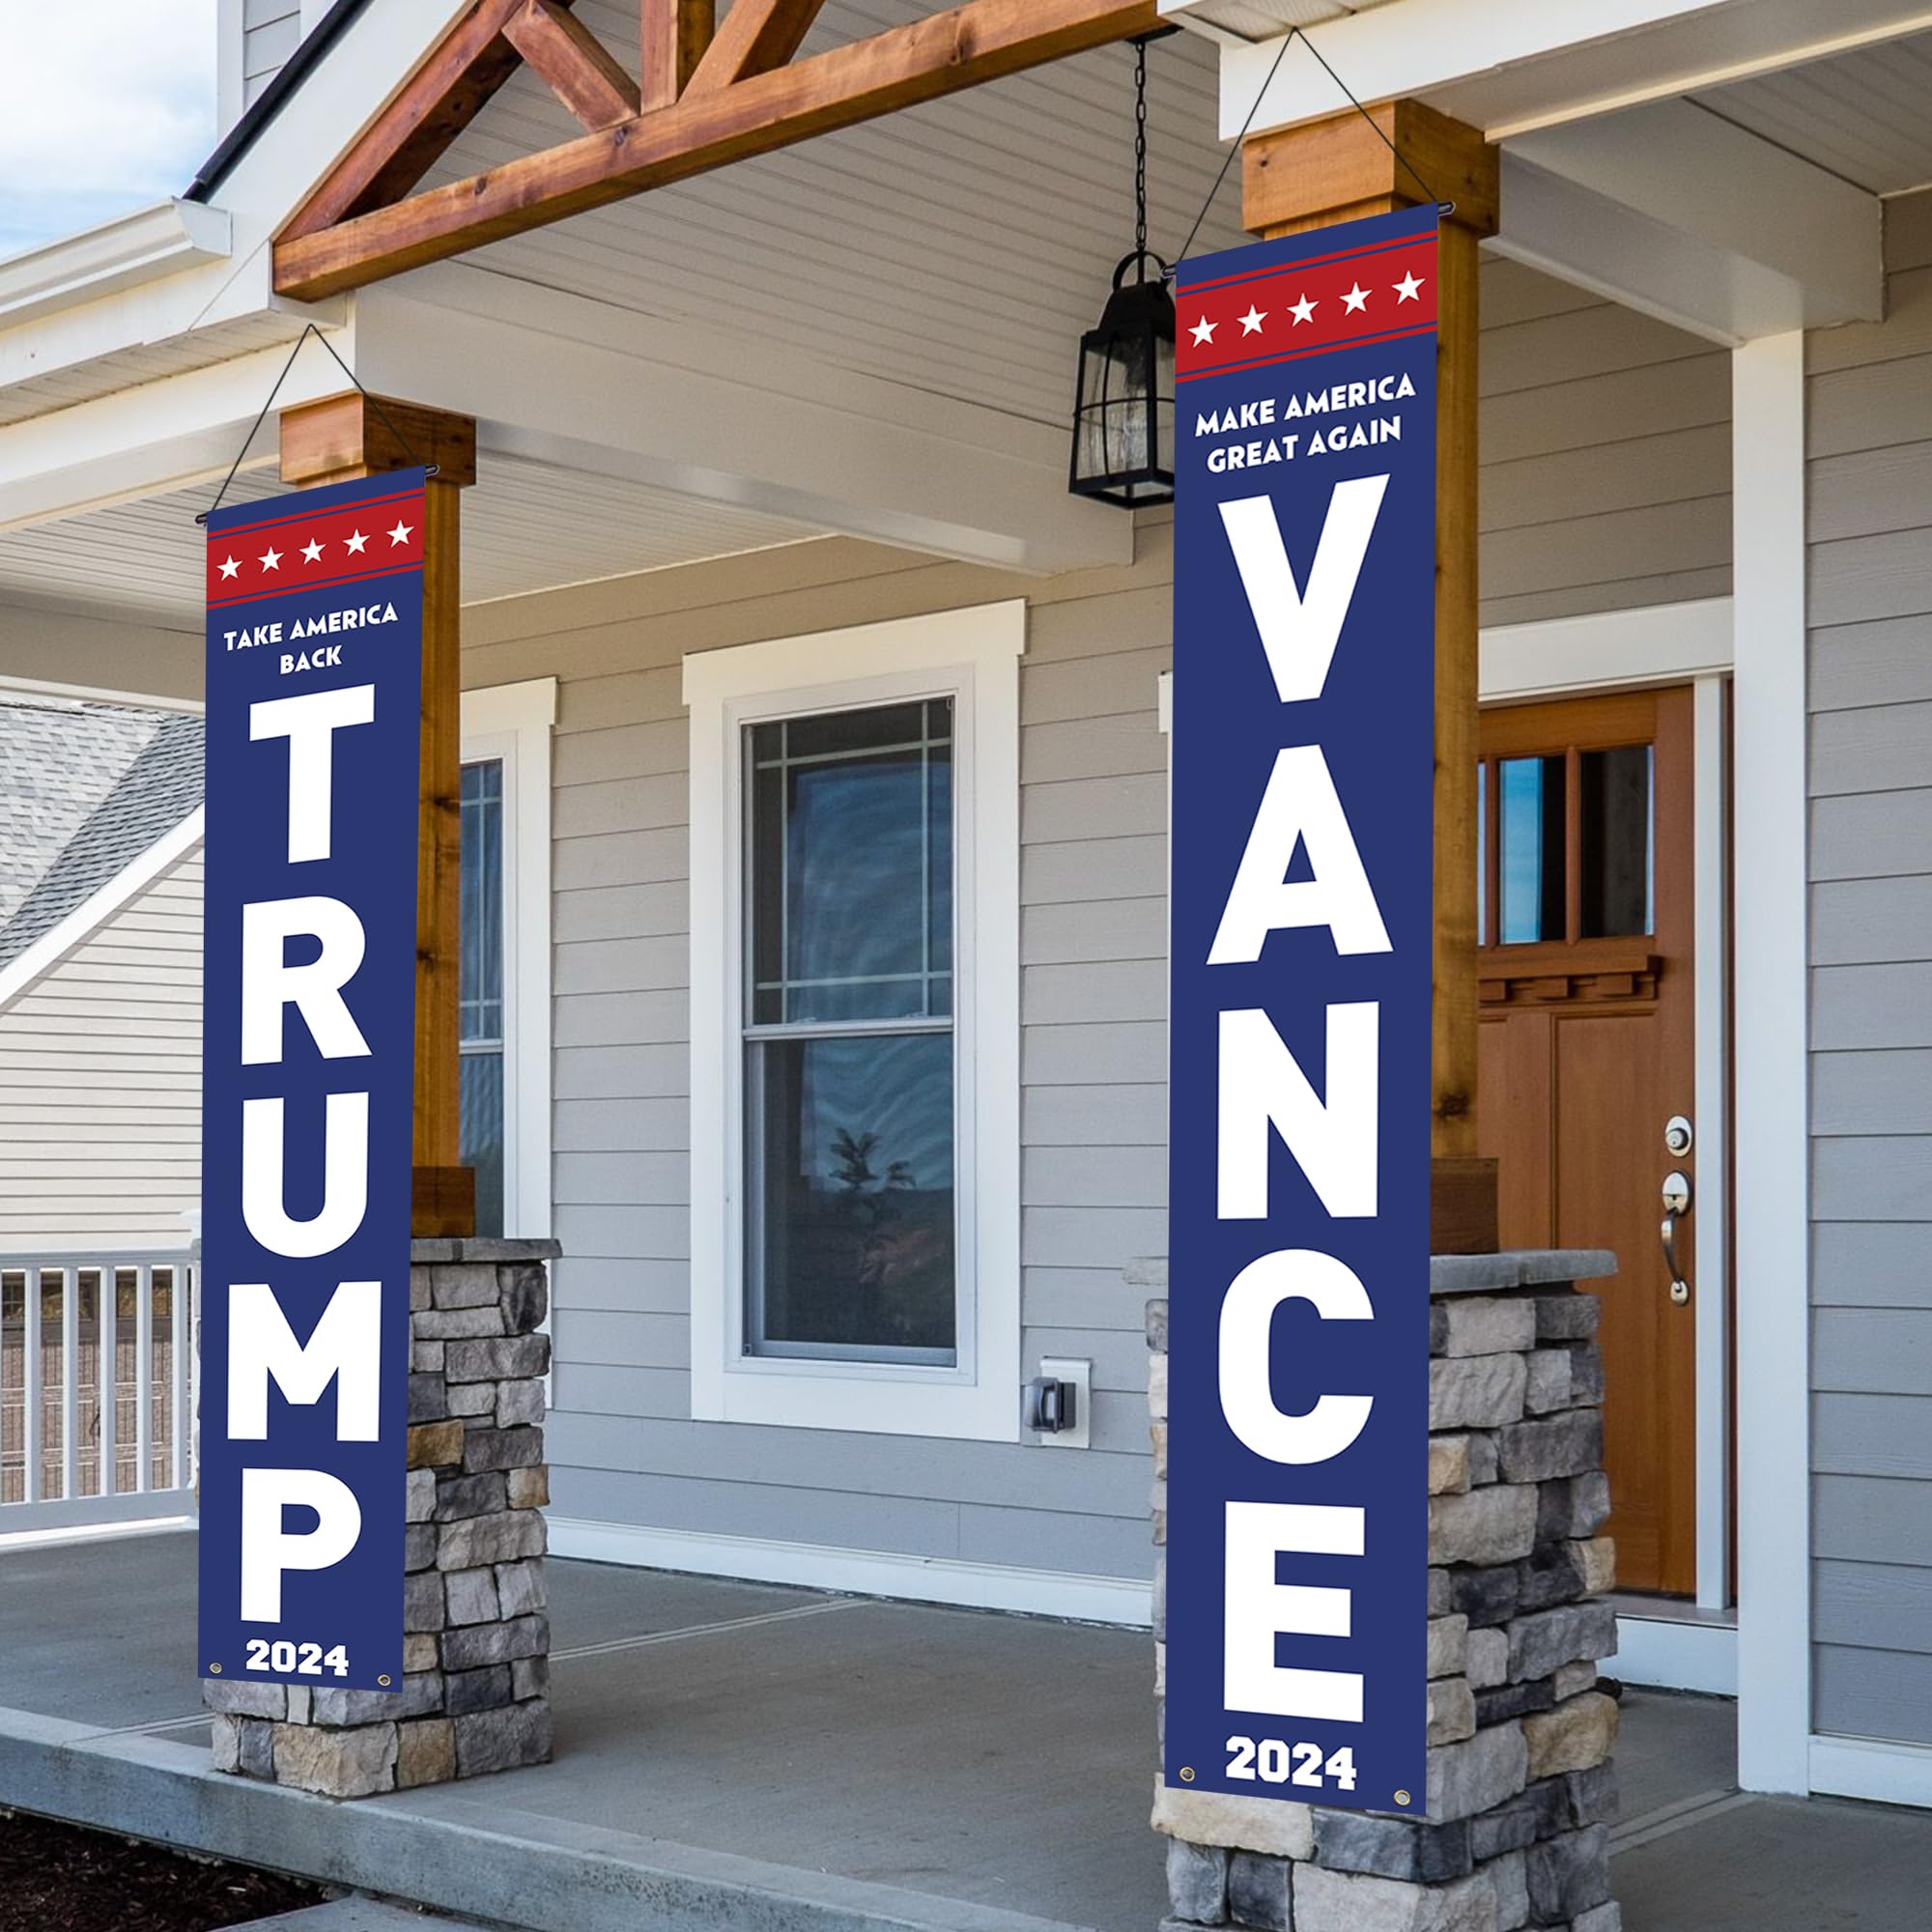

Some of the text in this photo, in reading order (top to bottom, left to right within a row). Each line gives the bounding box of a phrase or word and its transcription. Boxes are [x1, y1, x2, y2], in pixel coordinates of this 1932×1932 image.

[1195, 372, 1416, 438] MAKE AMERICA
[1207, 415, 1401, 473] GREAT AGAIN
[223, 602, 399, 651] TAKE AMERICA
[280, 644, 342, 674] BACK
[1206, 473, 1394, 1723] VANCE
[227, 683, 382, 1624] TRUMP
[245, 1638, 350, 1677] 2024
[1226, 1735, 1357, 1791] 2024
